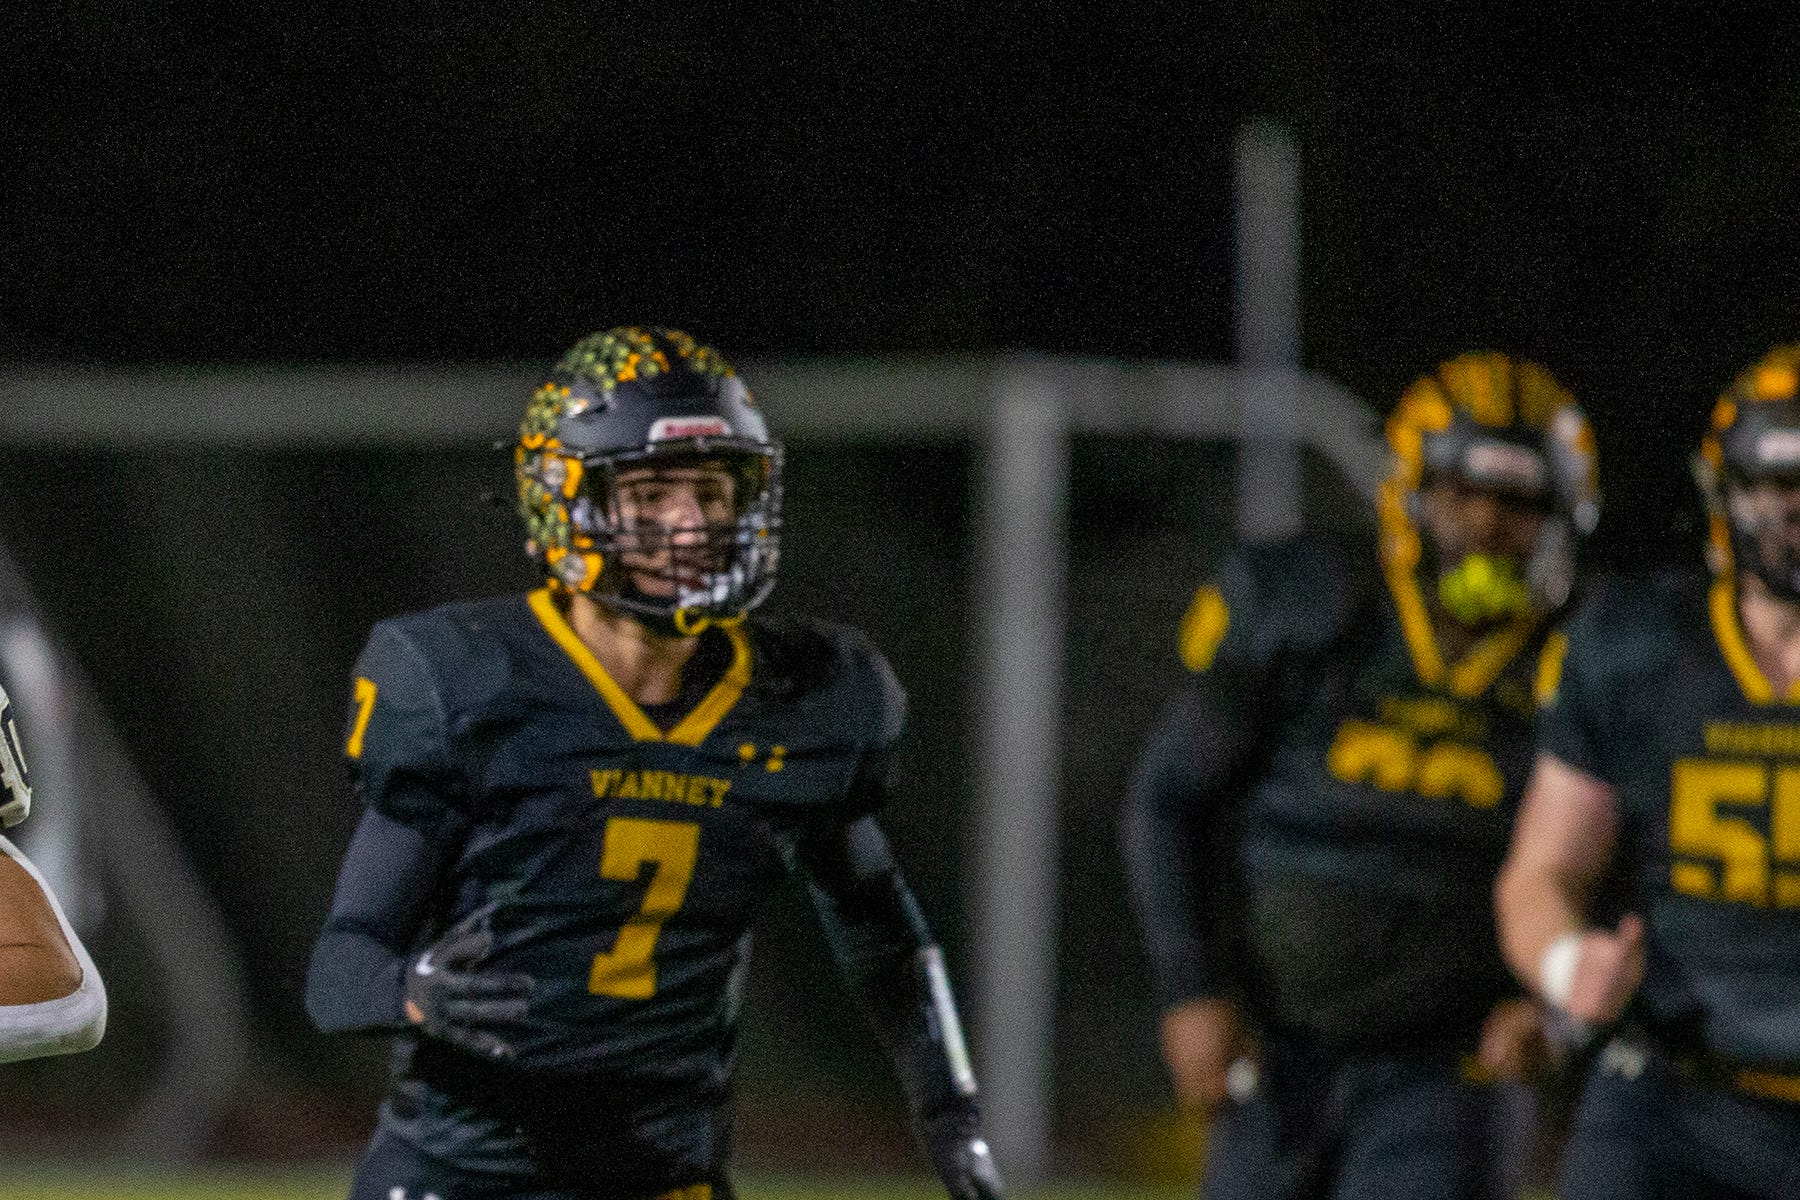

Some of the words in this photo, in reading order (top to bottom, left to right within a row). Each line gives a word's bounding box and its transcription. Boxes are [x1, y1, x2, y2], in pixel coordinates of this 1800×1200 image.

[590, 768, 732, 807] VIANNEY
[1670, 756, 1800, 908] 5
[588, 817, 700, 998] 7
